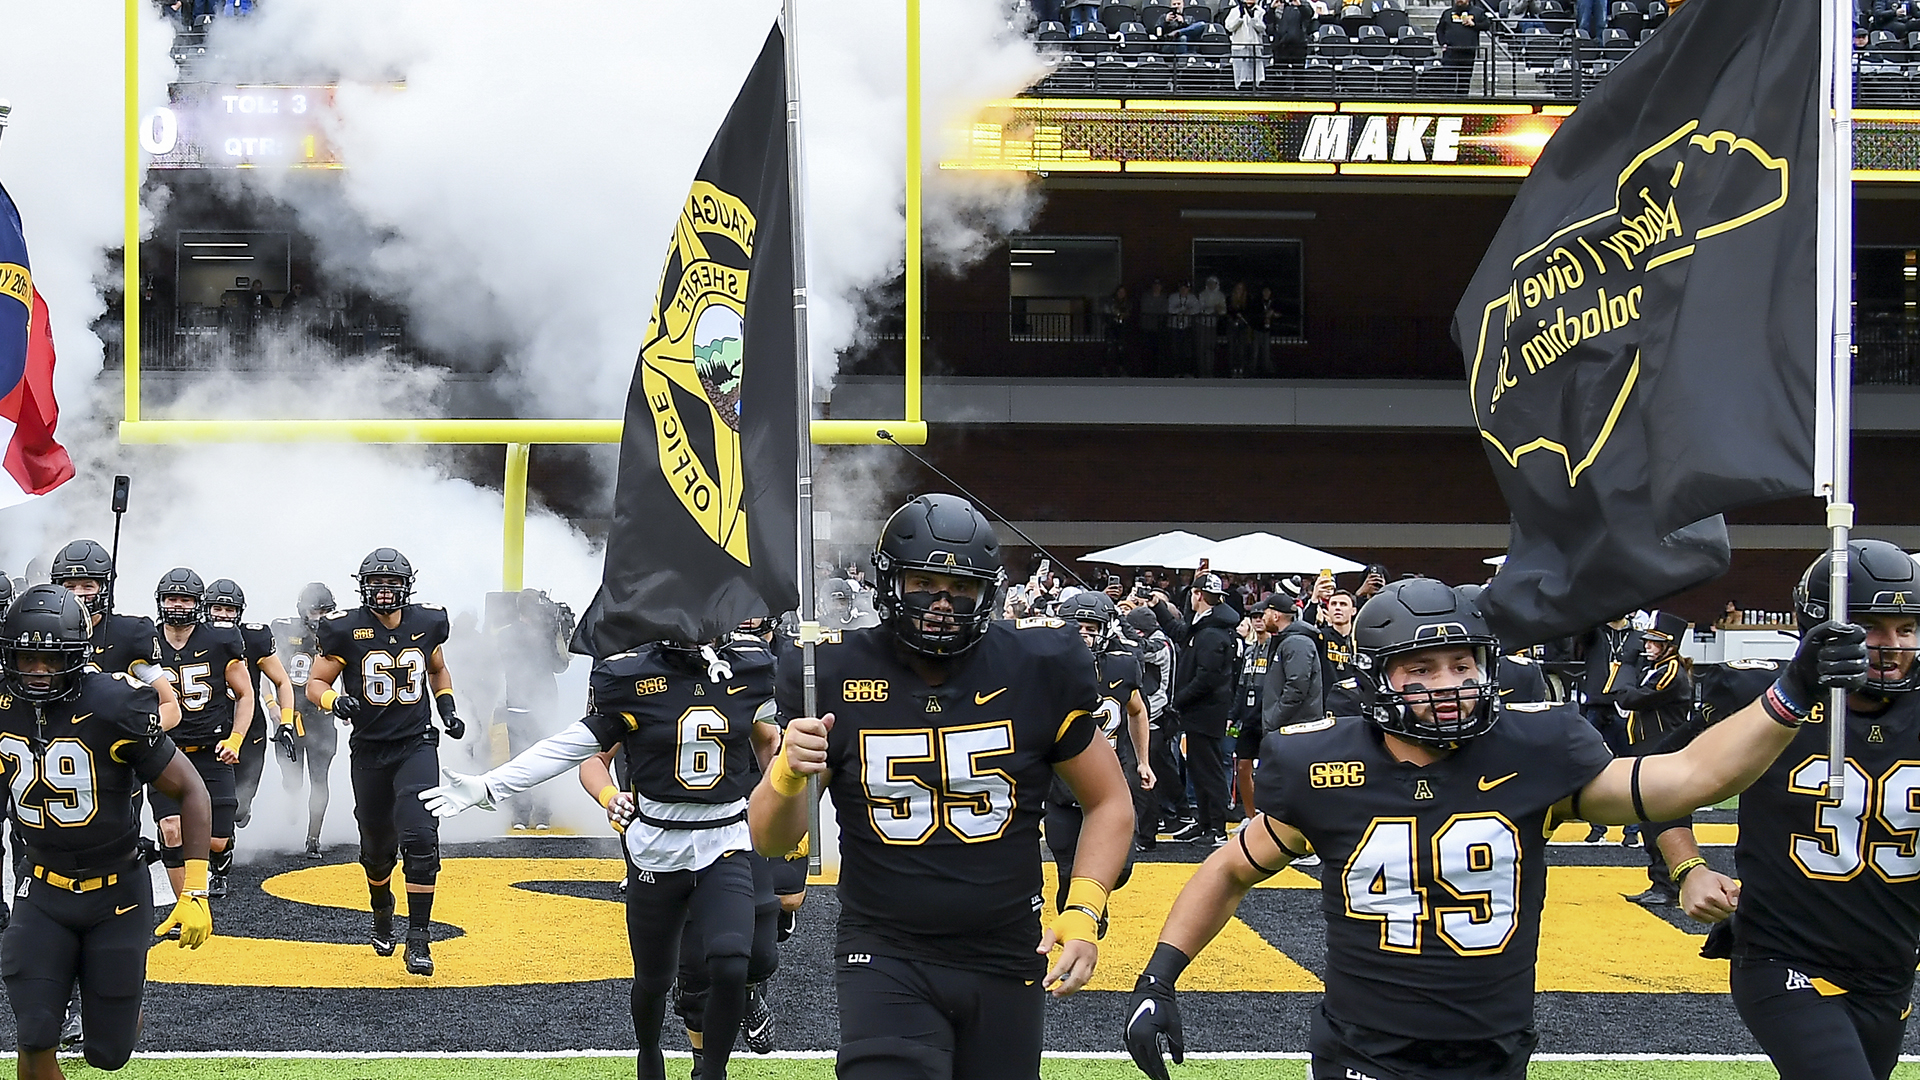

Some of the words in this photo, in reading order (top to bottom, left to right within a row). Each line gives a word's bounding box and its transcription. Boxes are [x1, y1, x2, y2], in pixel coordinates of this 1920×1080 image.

[222, 95, 279, 114] TOL:
[291, 94, 307, 114] 3
[139, 107, 178, 155] 0
[304, 134, 314, 158] 1
[1299, 114, 1464, 163] MAKE
[361, 647, 427, 707] 63
[635, 676, 667, 696] SBC
[843, 679, 889, 702] SBC
[674, 705, 730, 791] 6
[0, 732, 99, 829] 29
[859, 719, 1018, 846] 55
[1310, 761, 1365, 788] SBC
[1787, 754, 1920, 884] 39
[1341, 811, 1522, 957] 49
